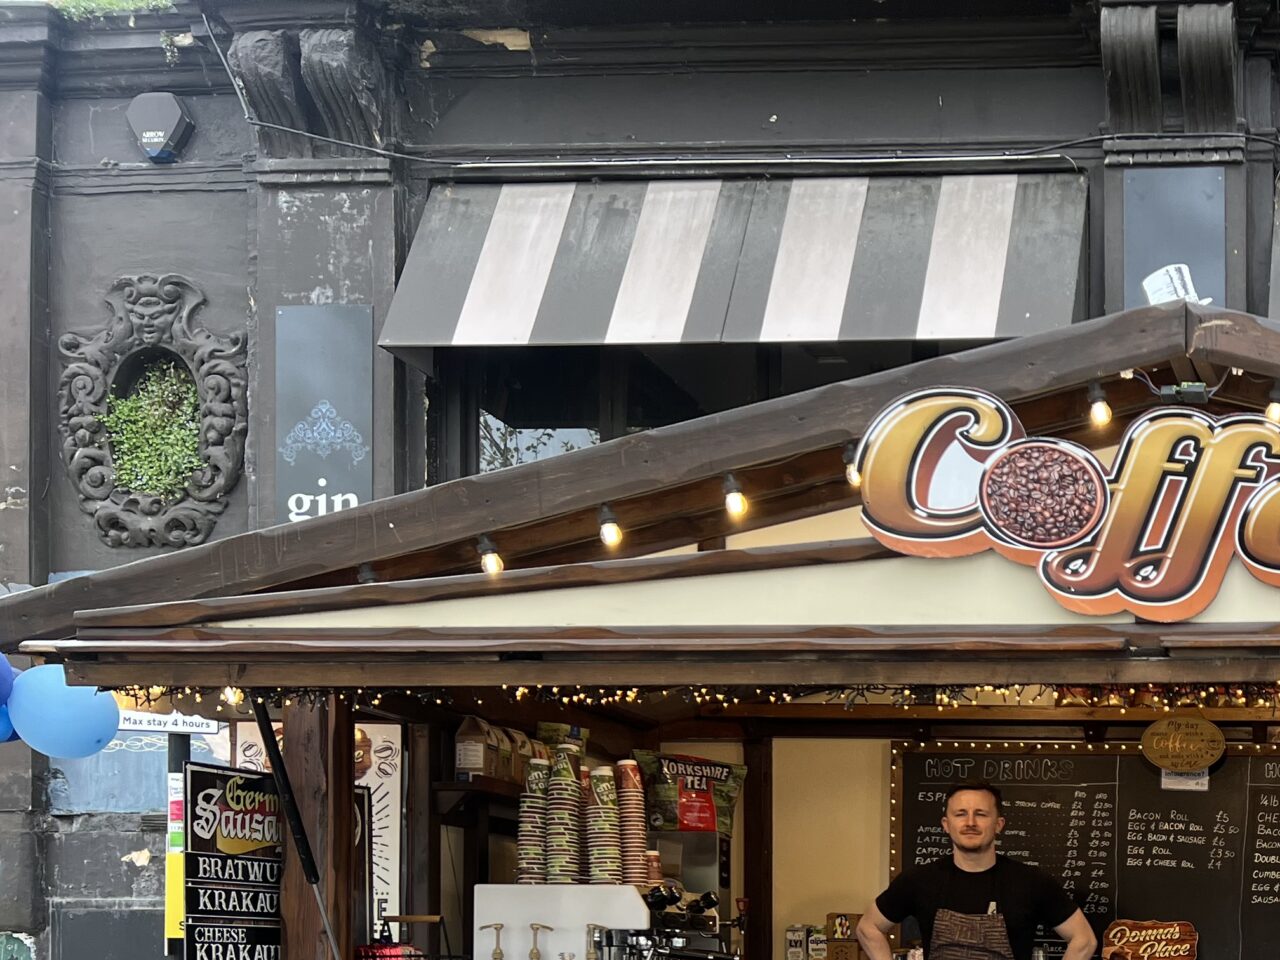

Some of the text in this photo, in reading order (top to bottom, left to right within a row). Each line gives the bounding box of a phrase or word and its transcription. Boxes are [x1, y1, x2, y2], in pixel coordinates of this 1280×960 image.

[288, 478, 358, 522] gin
[122, 716, 143, 725] Max
[147, 719, 167, 728] stay
[182, 720, 210, 728] hours
[661, 759, 729, 780] YORKSHIRE
[925, 758, 1074, 780] HOT DRINKS
[686, 776, 707, 790] TEA
[193, 788, 283, 842] Sausa
[1128, 809, 1229, 823] BACON ROLL £5
[1128, 822, 1145, 830] EGG
[1159, 822, 1185, 830] BACON
[1189, 823, 1204, 831] ROLL
[1147, 833, 1167, 841] BACON
[1177, 835, 1206, 844] SAUSAGE
[1212, 836, 1225, 846] £6
[1127, 846, 1172, 855] EGG ROLL
[1127, 858, 1142, 866] EGG
[1153, 859, 1177, 867] CHEESE
[1208, 859, 1222, 870] £4
[1252, 883, 1270, 891] EGG
[195, 927, 246, 943] CHEESE
[1109, 924, 1181, 946] Donna's
[1138, 941, 1191, 960] Place
